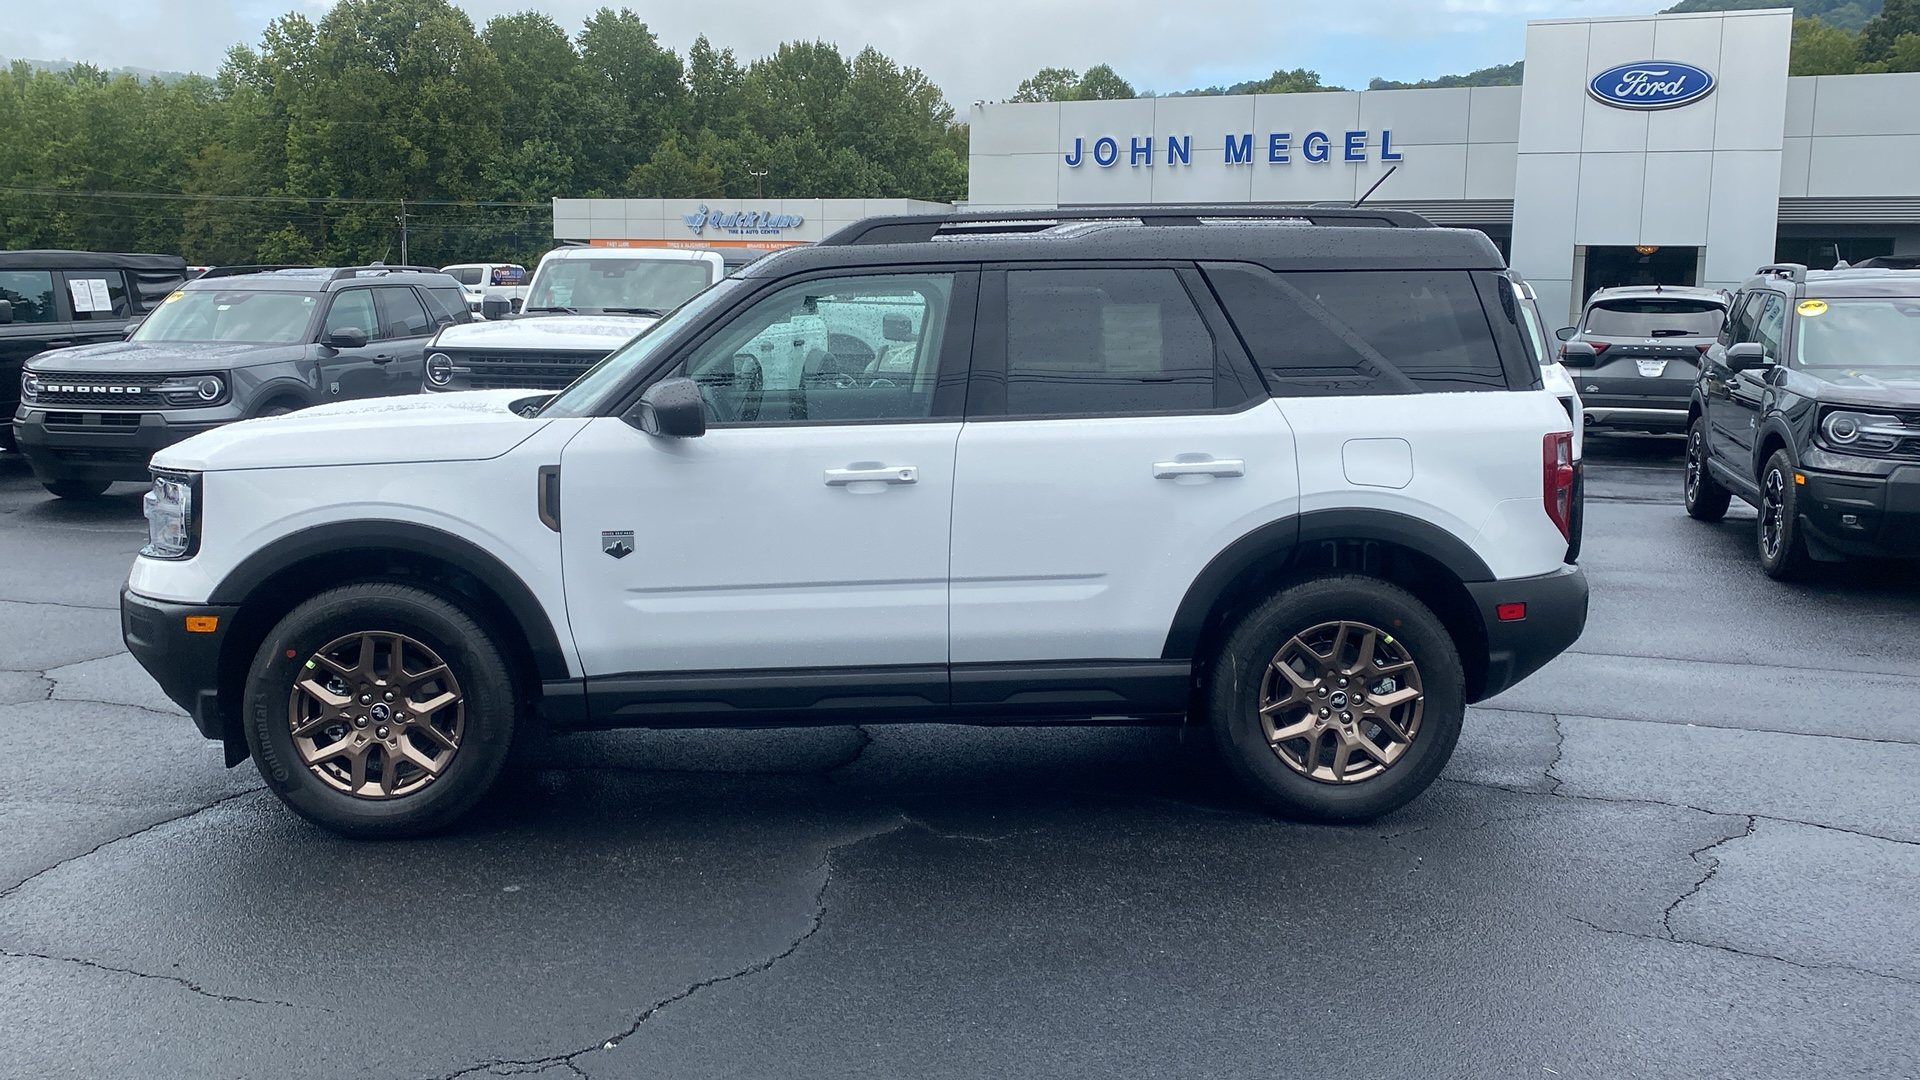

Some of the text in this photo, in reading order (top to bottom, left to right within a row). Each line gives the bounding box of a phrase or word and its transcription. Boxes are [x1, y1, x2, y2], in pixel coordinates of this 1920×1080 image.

[1614, 69, 1687, 97] Ford
[1064, 129, 1404, 168] JOHN MEGEL
[47, 385, 141, 394] BRONCO
